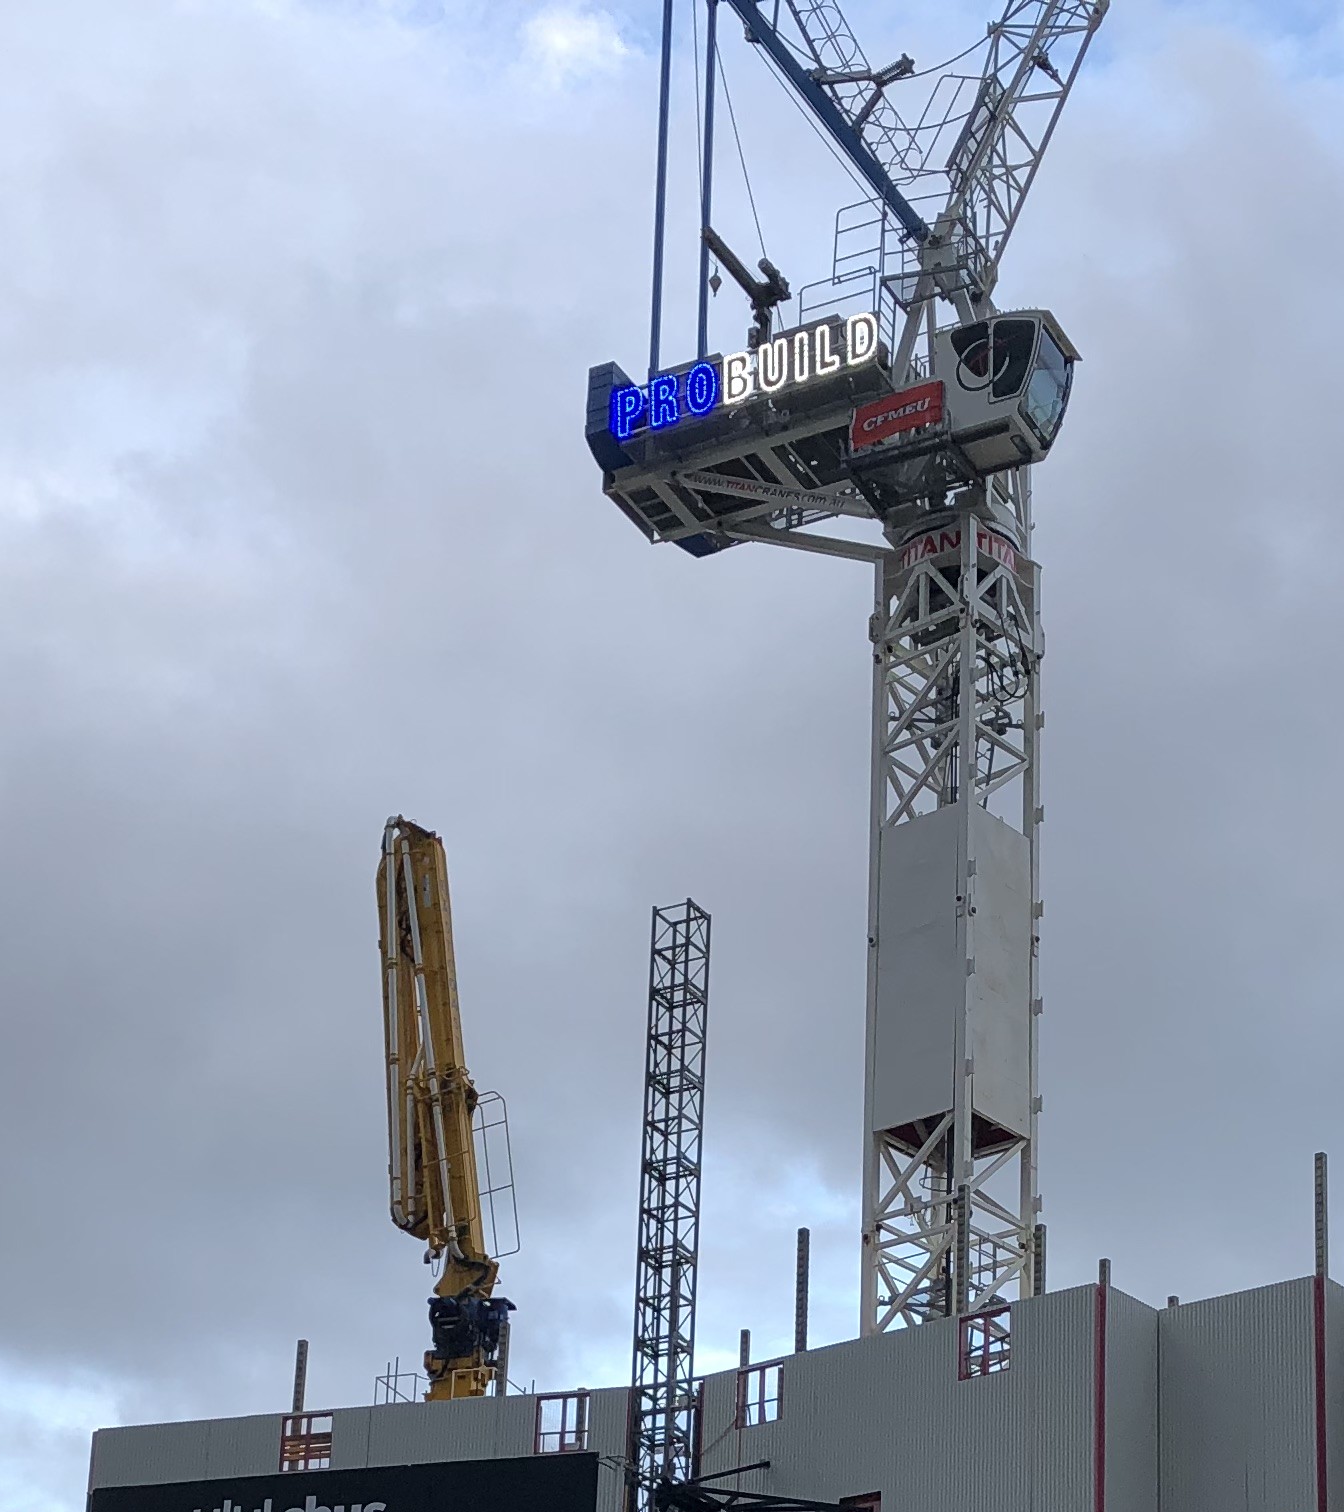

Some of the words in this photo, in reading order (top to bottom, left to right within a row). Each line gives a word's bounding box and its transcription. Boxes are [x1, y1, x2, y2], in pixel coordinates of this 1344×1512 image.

[610, 313, 879, 441] PROBUILD
[862, 398, 931, 432] CFMEU
[977, 532, 1017, 572] TITA
